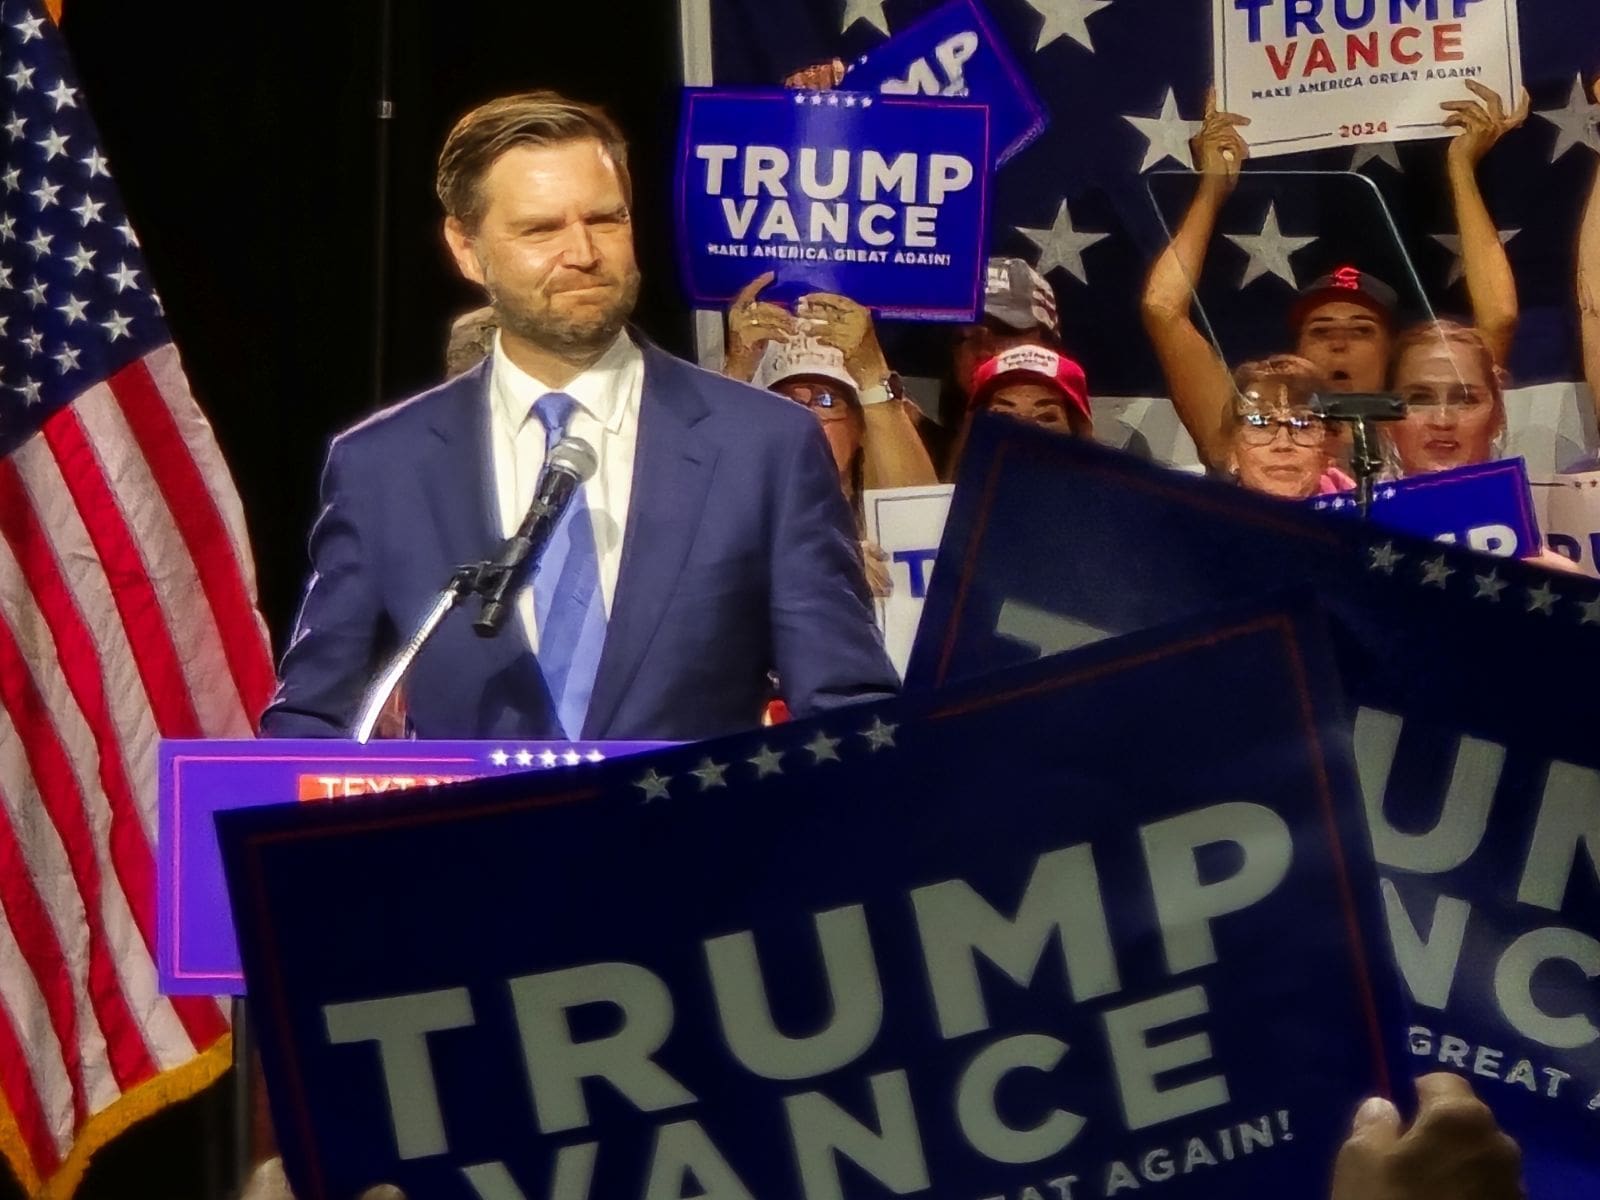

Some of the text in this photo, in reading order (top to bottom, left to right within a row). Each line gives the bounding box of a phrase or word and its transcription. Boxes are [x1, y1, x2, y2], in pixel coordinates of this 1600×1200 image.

[1265, 23, 1465, 81] VANCE
[1252, 65, 1482, 99] MAKE AMERICA GREAT AGAIN!
[1338, 121, 1388, 138] 2024
[696, 144, 973, 205] TRUMP
[720, 198, 938, 247] VANCE
[707, 243, 951, 266] MAKE AMERICA GREAT AGAIN!
[323, 802, 1293, 1160] TRUMP
[1408, 1026, 1571, 1098] GREAT
[1106, 1110, 1293, 1197] AGAIN!
